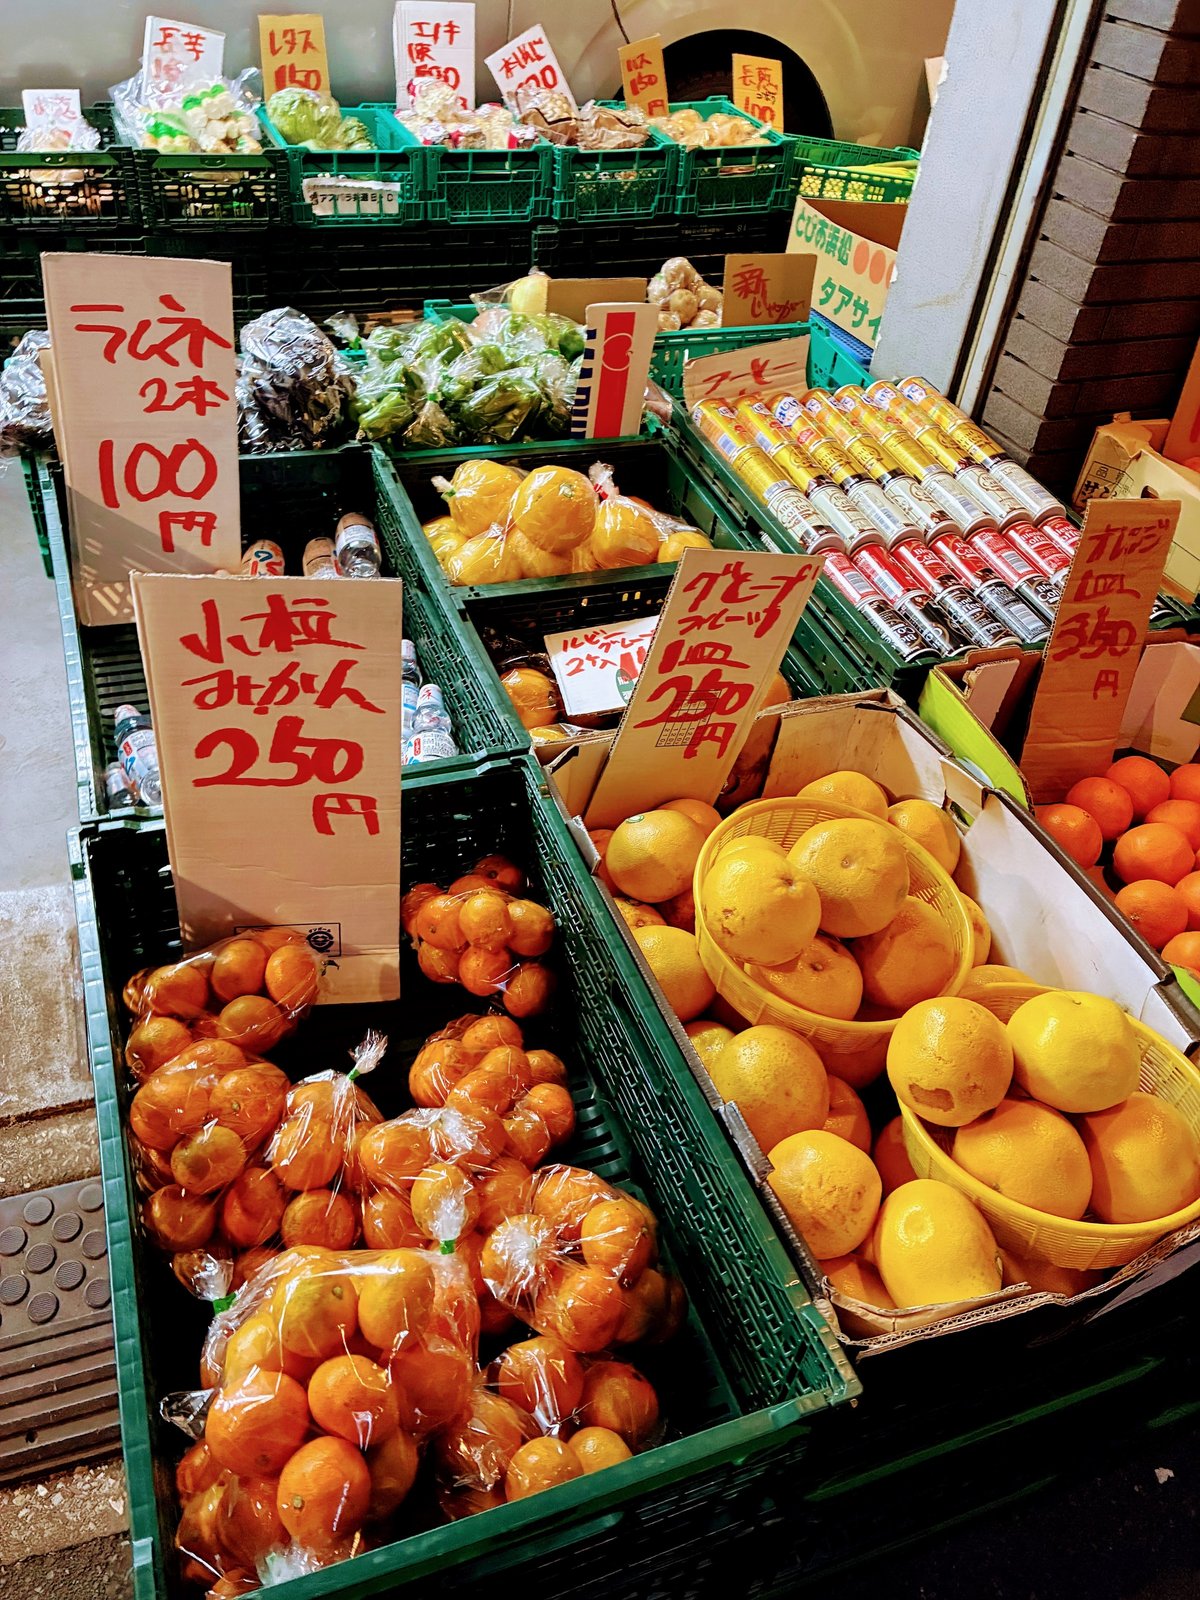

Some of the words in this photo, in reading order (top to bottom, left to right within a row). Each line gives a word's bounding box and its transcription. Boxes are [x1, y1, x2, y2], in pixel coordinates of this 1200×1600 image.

[268, 28, 321, 57] レタス
[274, 63, 322, 91] 150
[819, 276, 882, 341] タアサイ
[98, 438, 218, 509] 100
[159, 511, 218, 553] 円
[179, 593, 367, 665] 小粒
[1052, 605, 1137, 661] 350
[181, 659, 386, 715] みかん
[633, 669, 755, 729] 250
[1092, 669, 1119, 700] 円
[192, 715, 364, 787] 250
[683, 723, 738, 760] 円
[312, 793, 381, 836] 円
